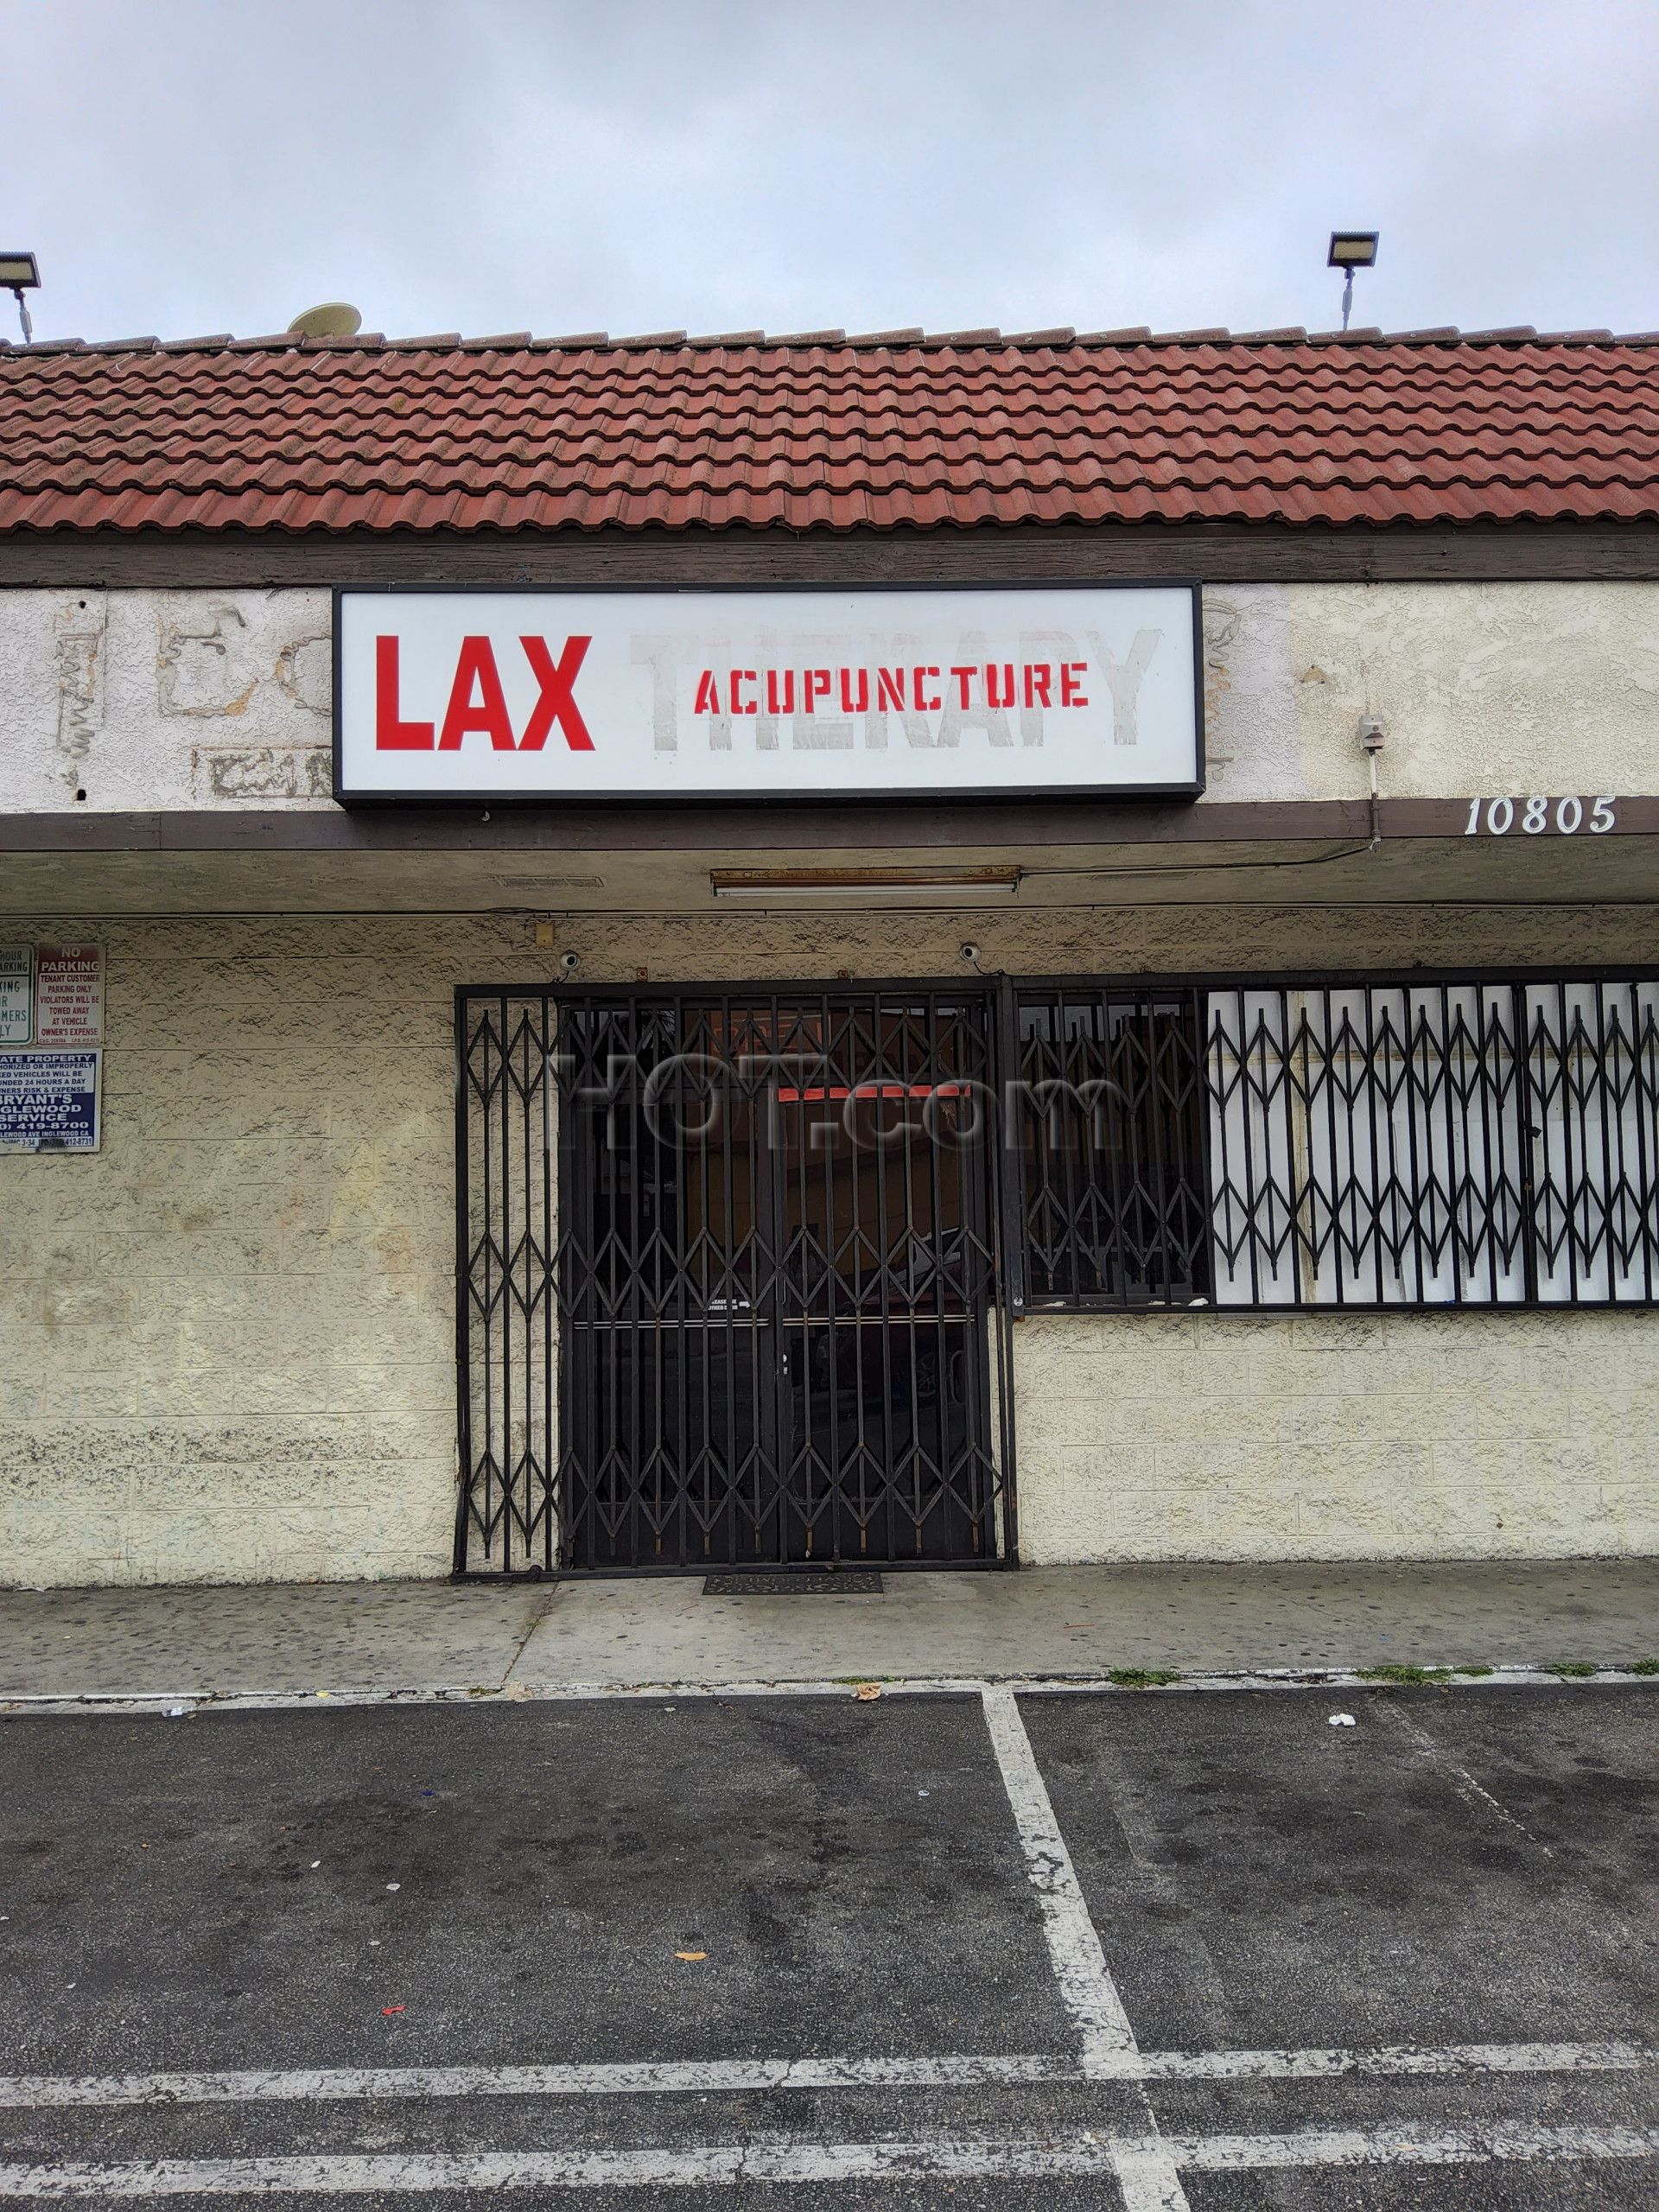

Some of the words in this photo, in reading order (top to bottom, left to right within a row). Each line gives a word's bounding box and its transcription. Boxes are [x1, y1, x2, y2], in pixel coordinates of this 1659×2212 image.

[376, 635, 596, 751] LAX
[694, 661, 1090, 715] ACUPUNCTURE
[1465, 796, 1616, 835] 10805
[61, 947, 81, 958] NO
[41, 961, 99, 972] PARKING
[67, 974, 100, 982] CUSTOMER
[40, 995, 73, 1004] VIOLATORS
[69, 1027, 99, 1036] EXPENSE
[0, 1113, 67, 1122] SERVICE
